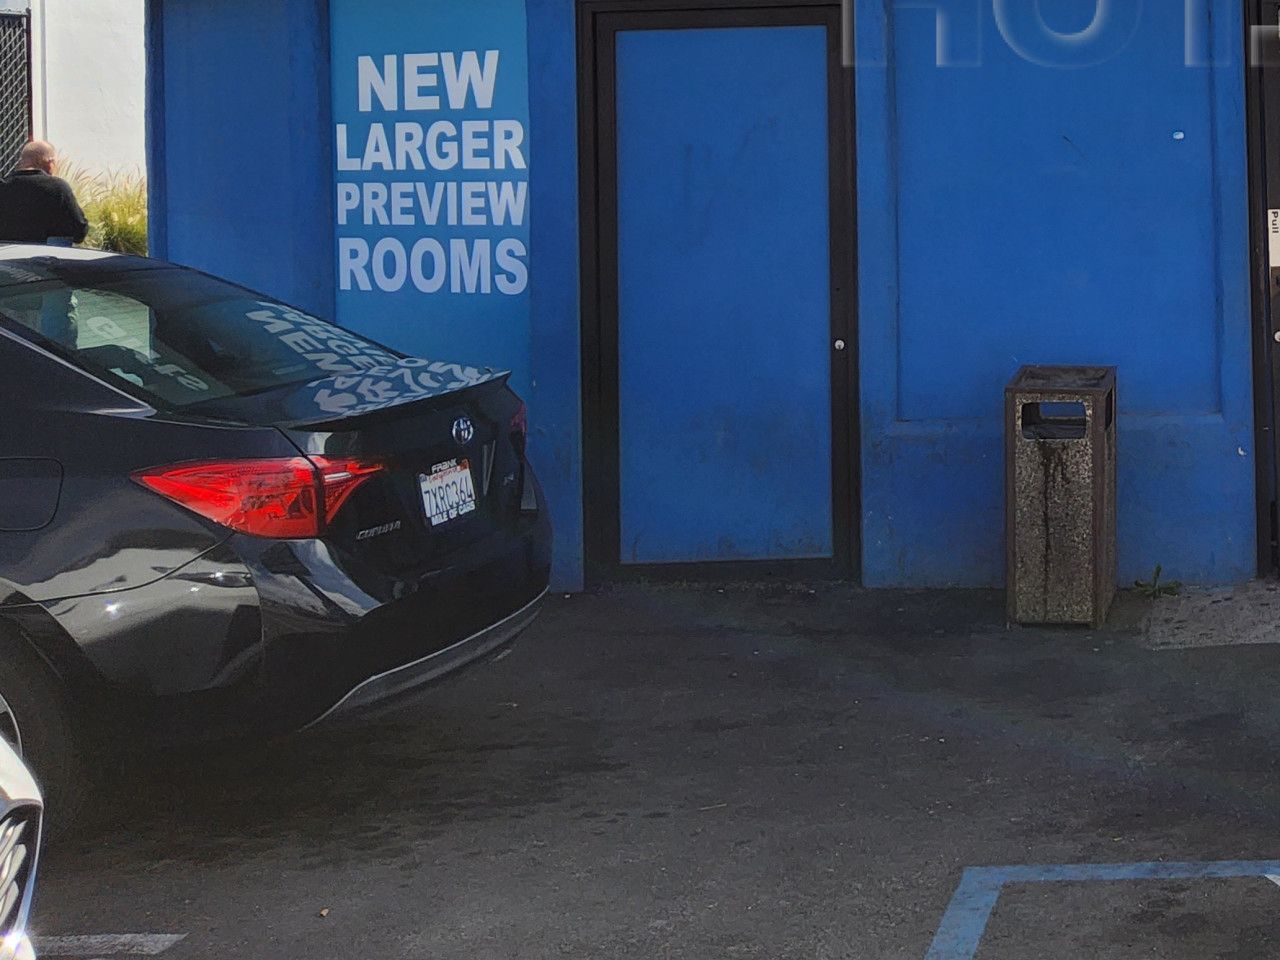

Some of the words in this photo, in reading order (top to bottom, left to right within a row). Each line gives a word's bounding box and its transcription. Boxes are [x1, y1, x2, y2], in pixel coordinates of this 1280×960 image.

[358, 50, 500, 112] NEW
[336, 120, 526, 172] LARGER
[337, 181, 528, 226] PREVIEW
[1271, 211, 1279, 234] Pull
[339, 237, 529, 296] ROOMS
[423, 476, 473, 518] 7XRC364
[448, 508, 458, 519] OF
